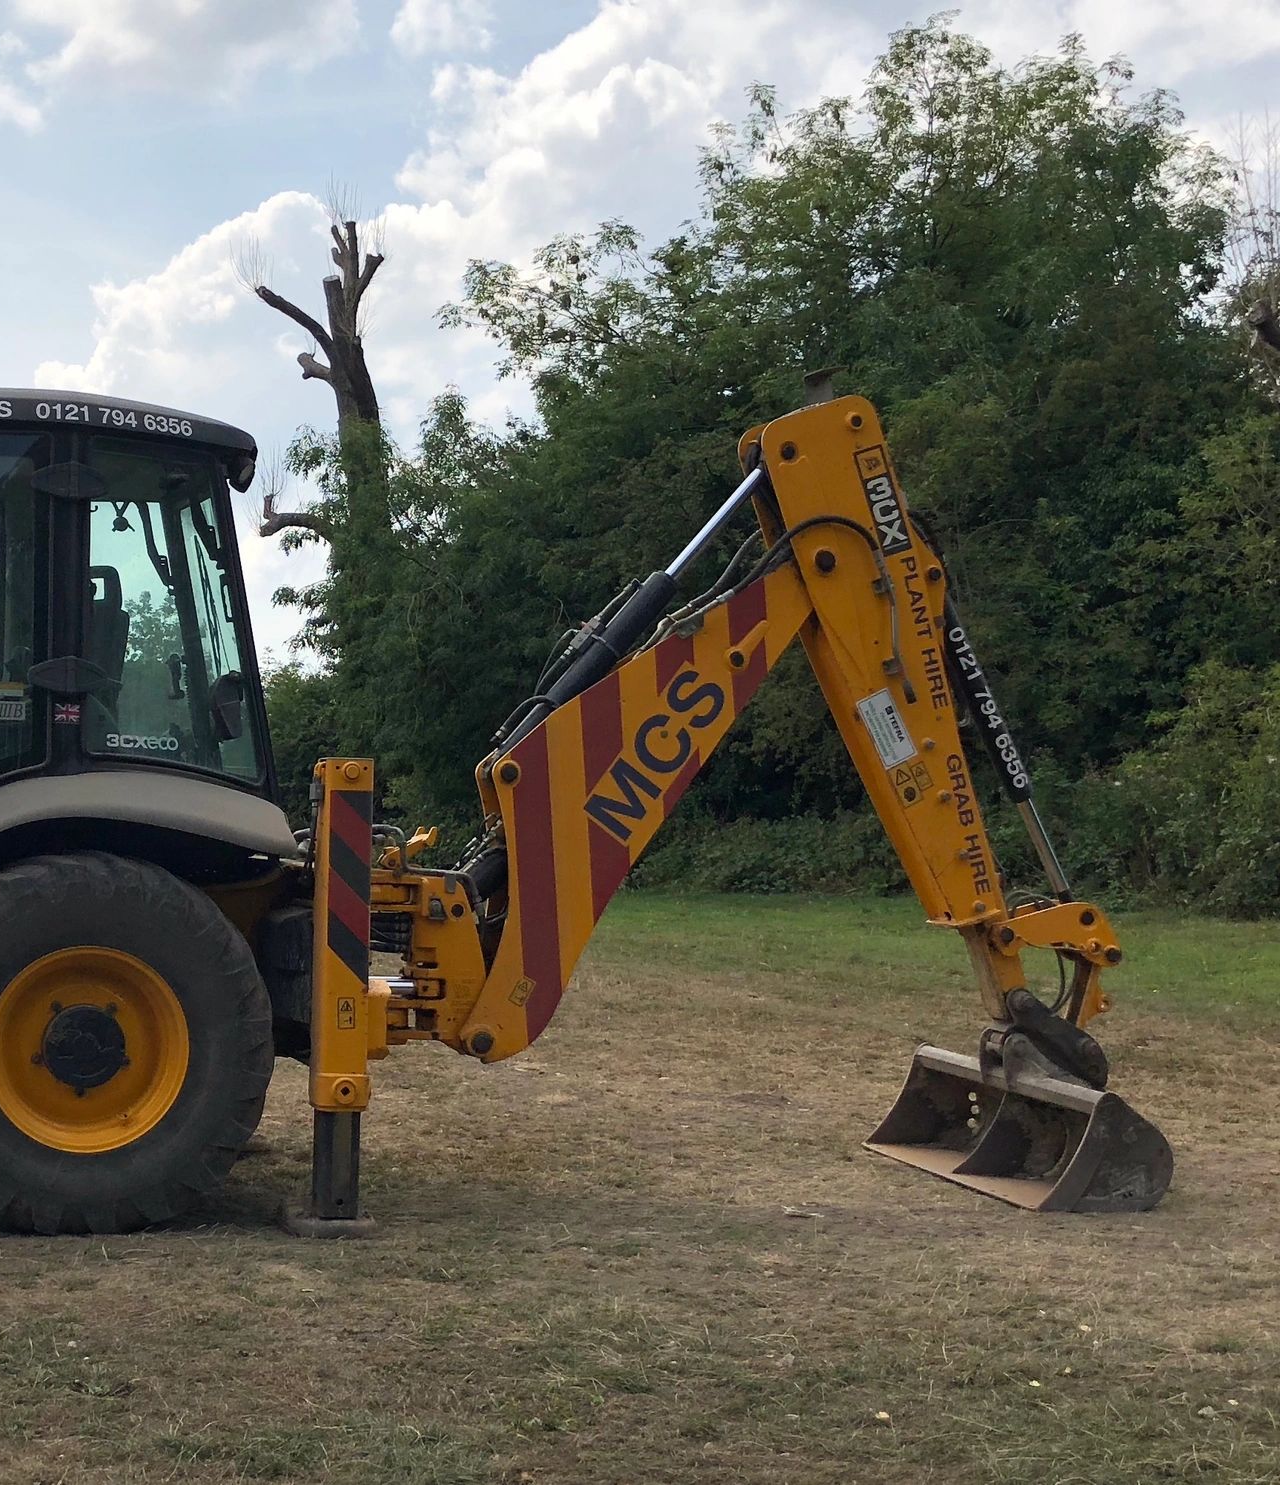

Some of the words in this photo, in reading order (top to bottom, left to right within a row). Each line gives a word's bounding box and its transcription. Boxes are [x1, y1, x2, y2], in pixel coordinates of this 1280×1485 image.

[35, 402, 91, 422] 0121
[98, 406, 138, 428] 794
[144, 413, 193, 437] 6356
[866, 476, 909, 546] 3CX
[900, 556, 932, 639] PLANT
[920, 647, 950, 710] HIRE
[105, 733, 179, 751] 3CXeco
[583, 669, 725, 842] MCS
[948, 626, 983, 681] 0121
[974, 685, 1003, 729] 794
[995, 733, 1029, 789] 6356
[946, 753, 975, 828] GRAB
[963, 833, 991, 896] HIRE
